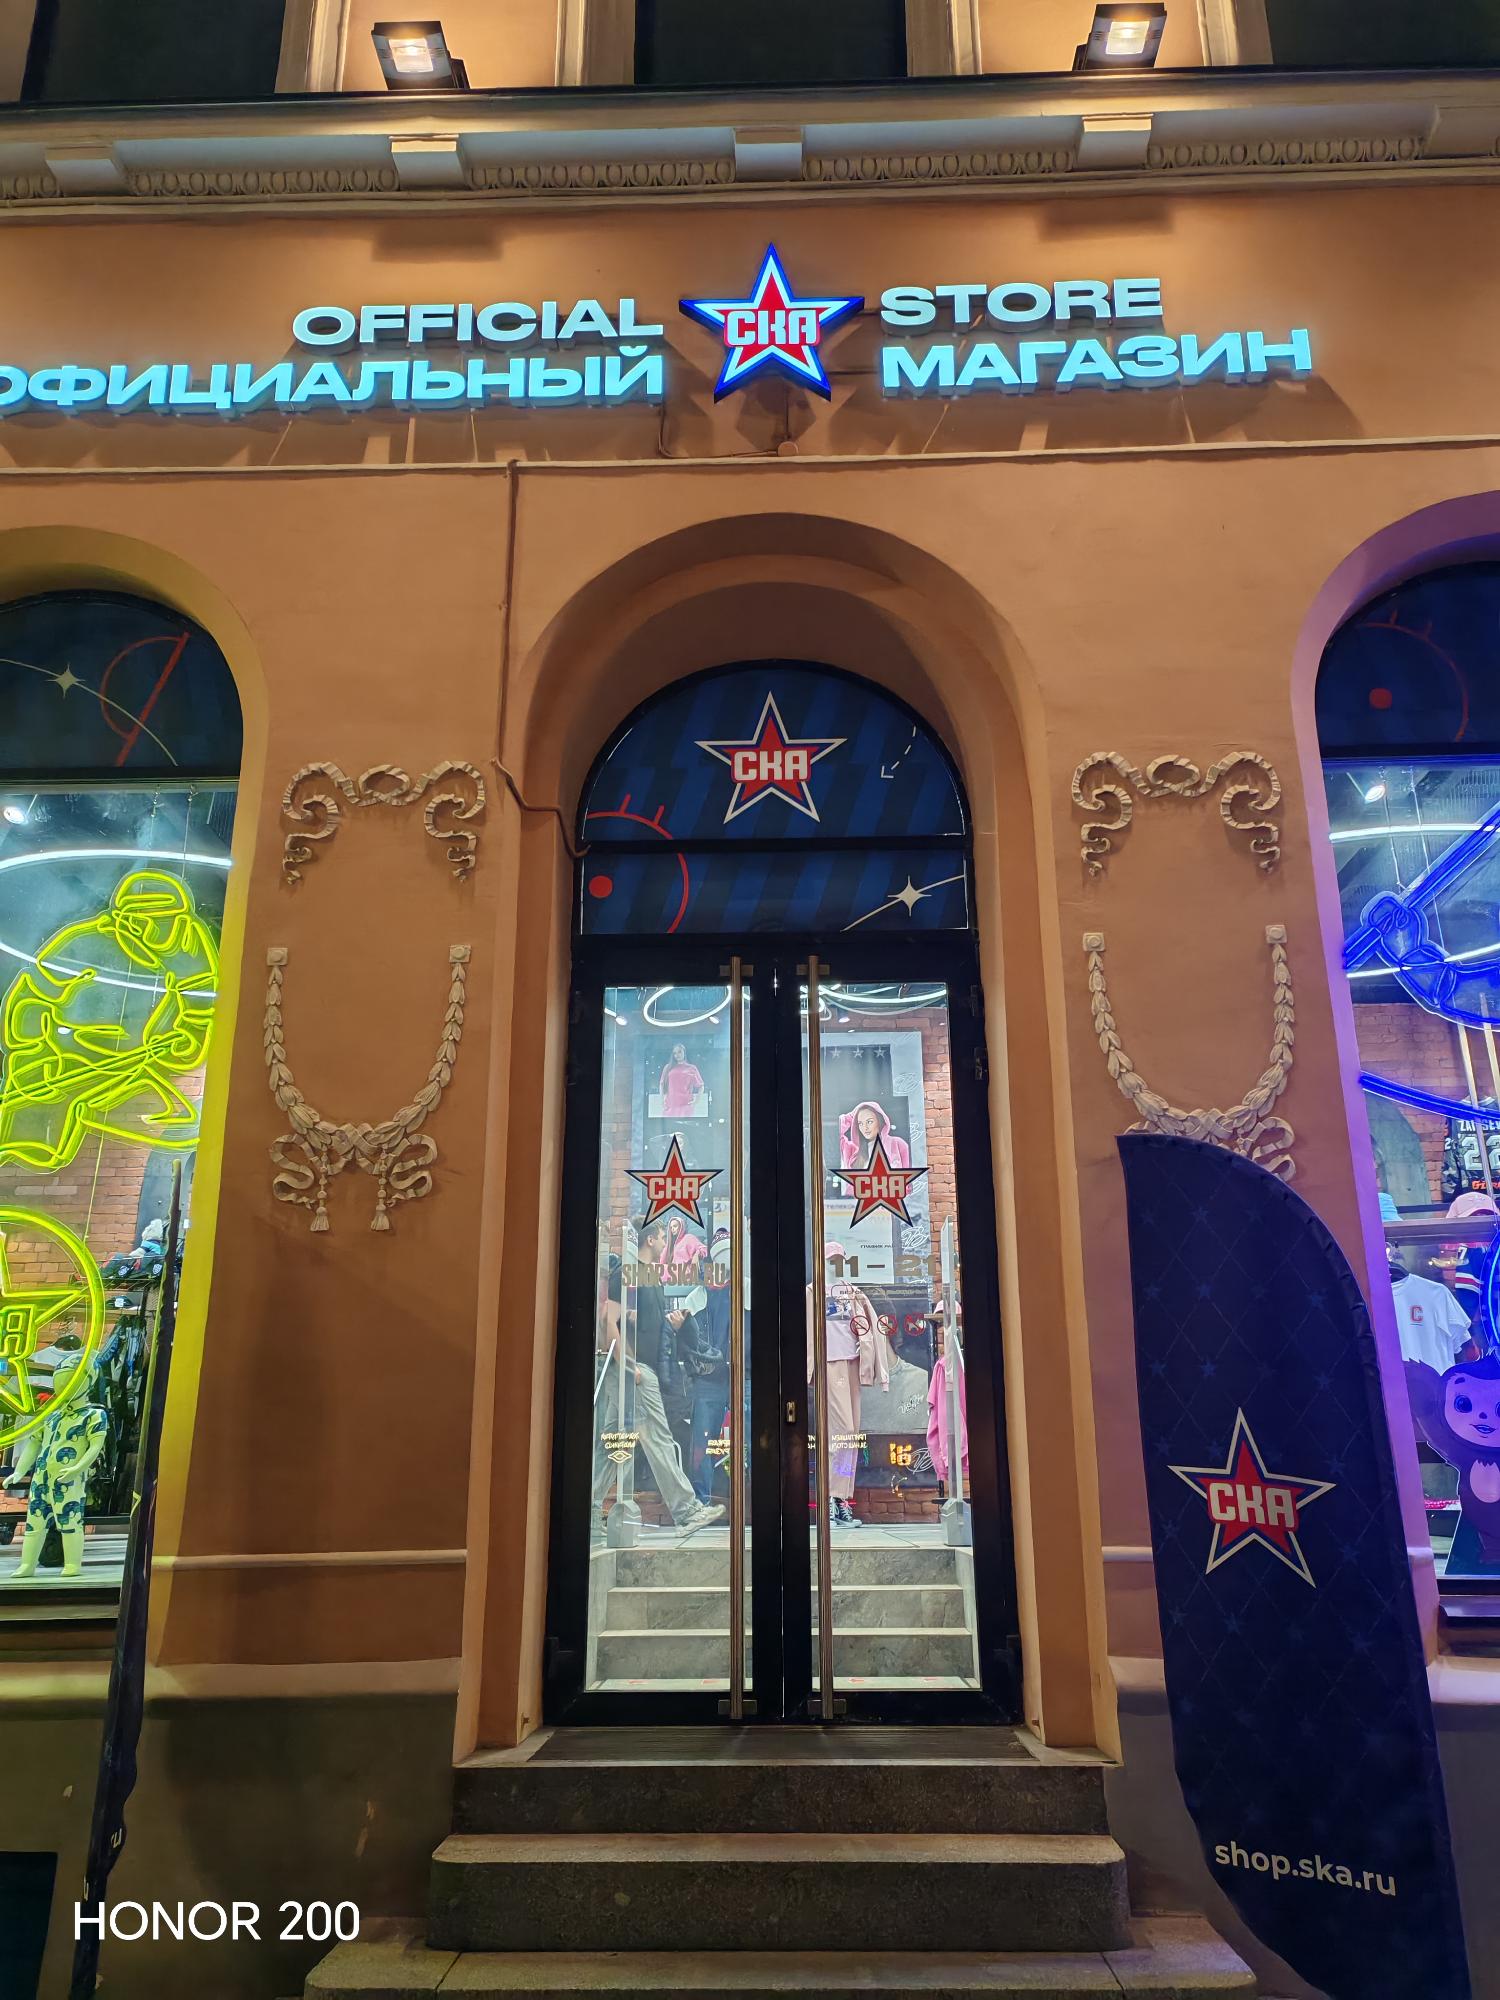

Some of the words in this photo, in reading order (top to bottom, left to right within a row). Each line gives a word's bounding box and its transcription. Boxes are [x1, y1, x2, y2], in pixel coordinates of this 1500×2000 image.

[292, 298, 664, 346] OFFICIAL
[880, 278, 1163, 327] STORE
[728, 309, 817, 346] СКА
[882, 329, 1312, 388] МАГАЗИН
[734, 750, 808, 781] СКА
[650, 1177, 699, 1200] СКА
[855, 1176, 904, 1199] СКА
[829, 1255, 859, 1277] 11
[1209, 1482, 1295, 1528] СКА
[1215, 1840, 1396, 1897] shop.ska.ru
